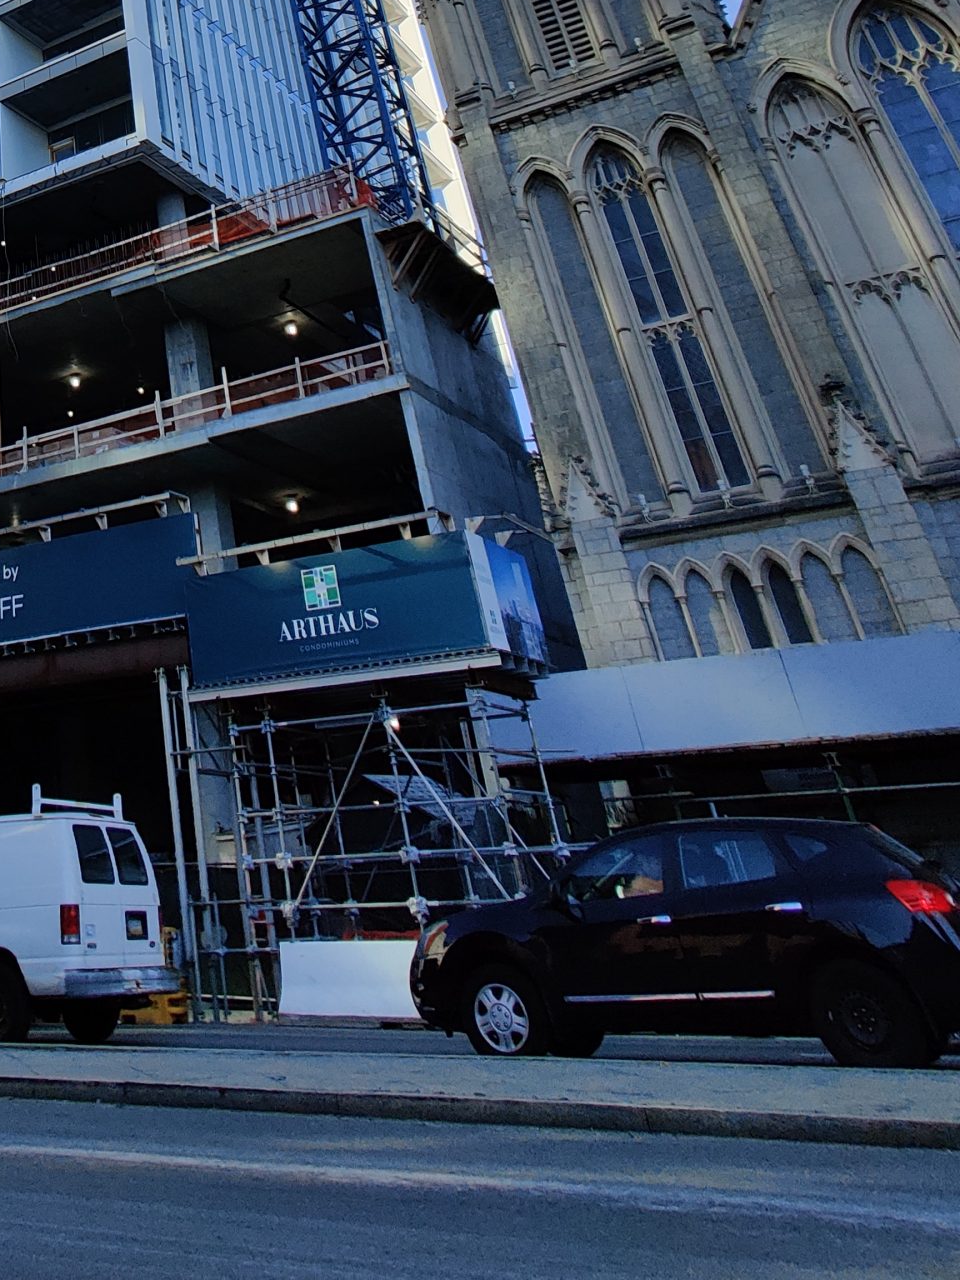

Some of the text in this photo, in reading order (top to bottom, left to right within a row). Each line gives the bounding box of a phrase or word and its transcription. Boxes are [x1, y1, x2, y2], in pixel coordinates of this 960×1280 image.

[3, 565, 19, 581] by
[279, 608, 380, 641] ARTHAUS
[300, 638, 360, 652] CONDOMINIUMS
